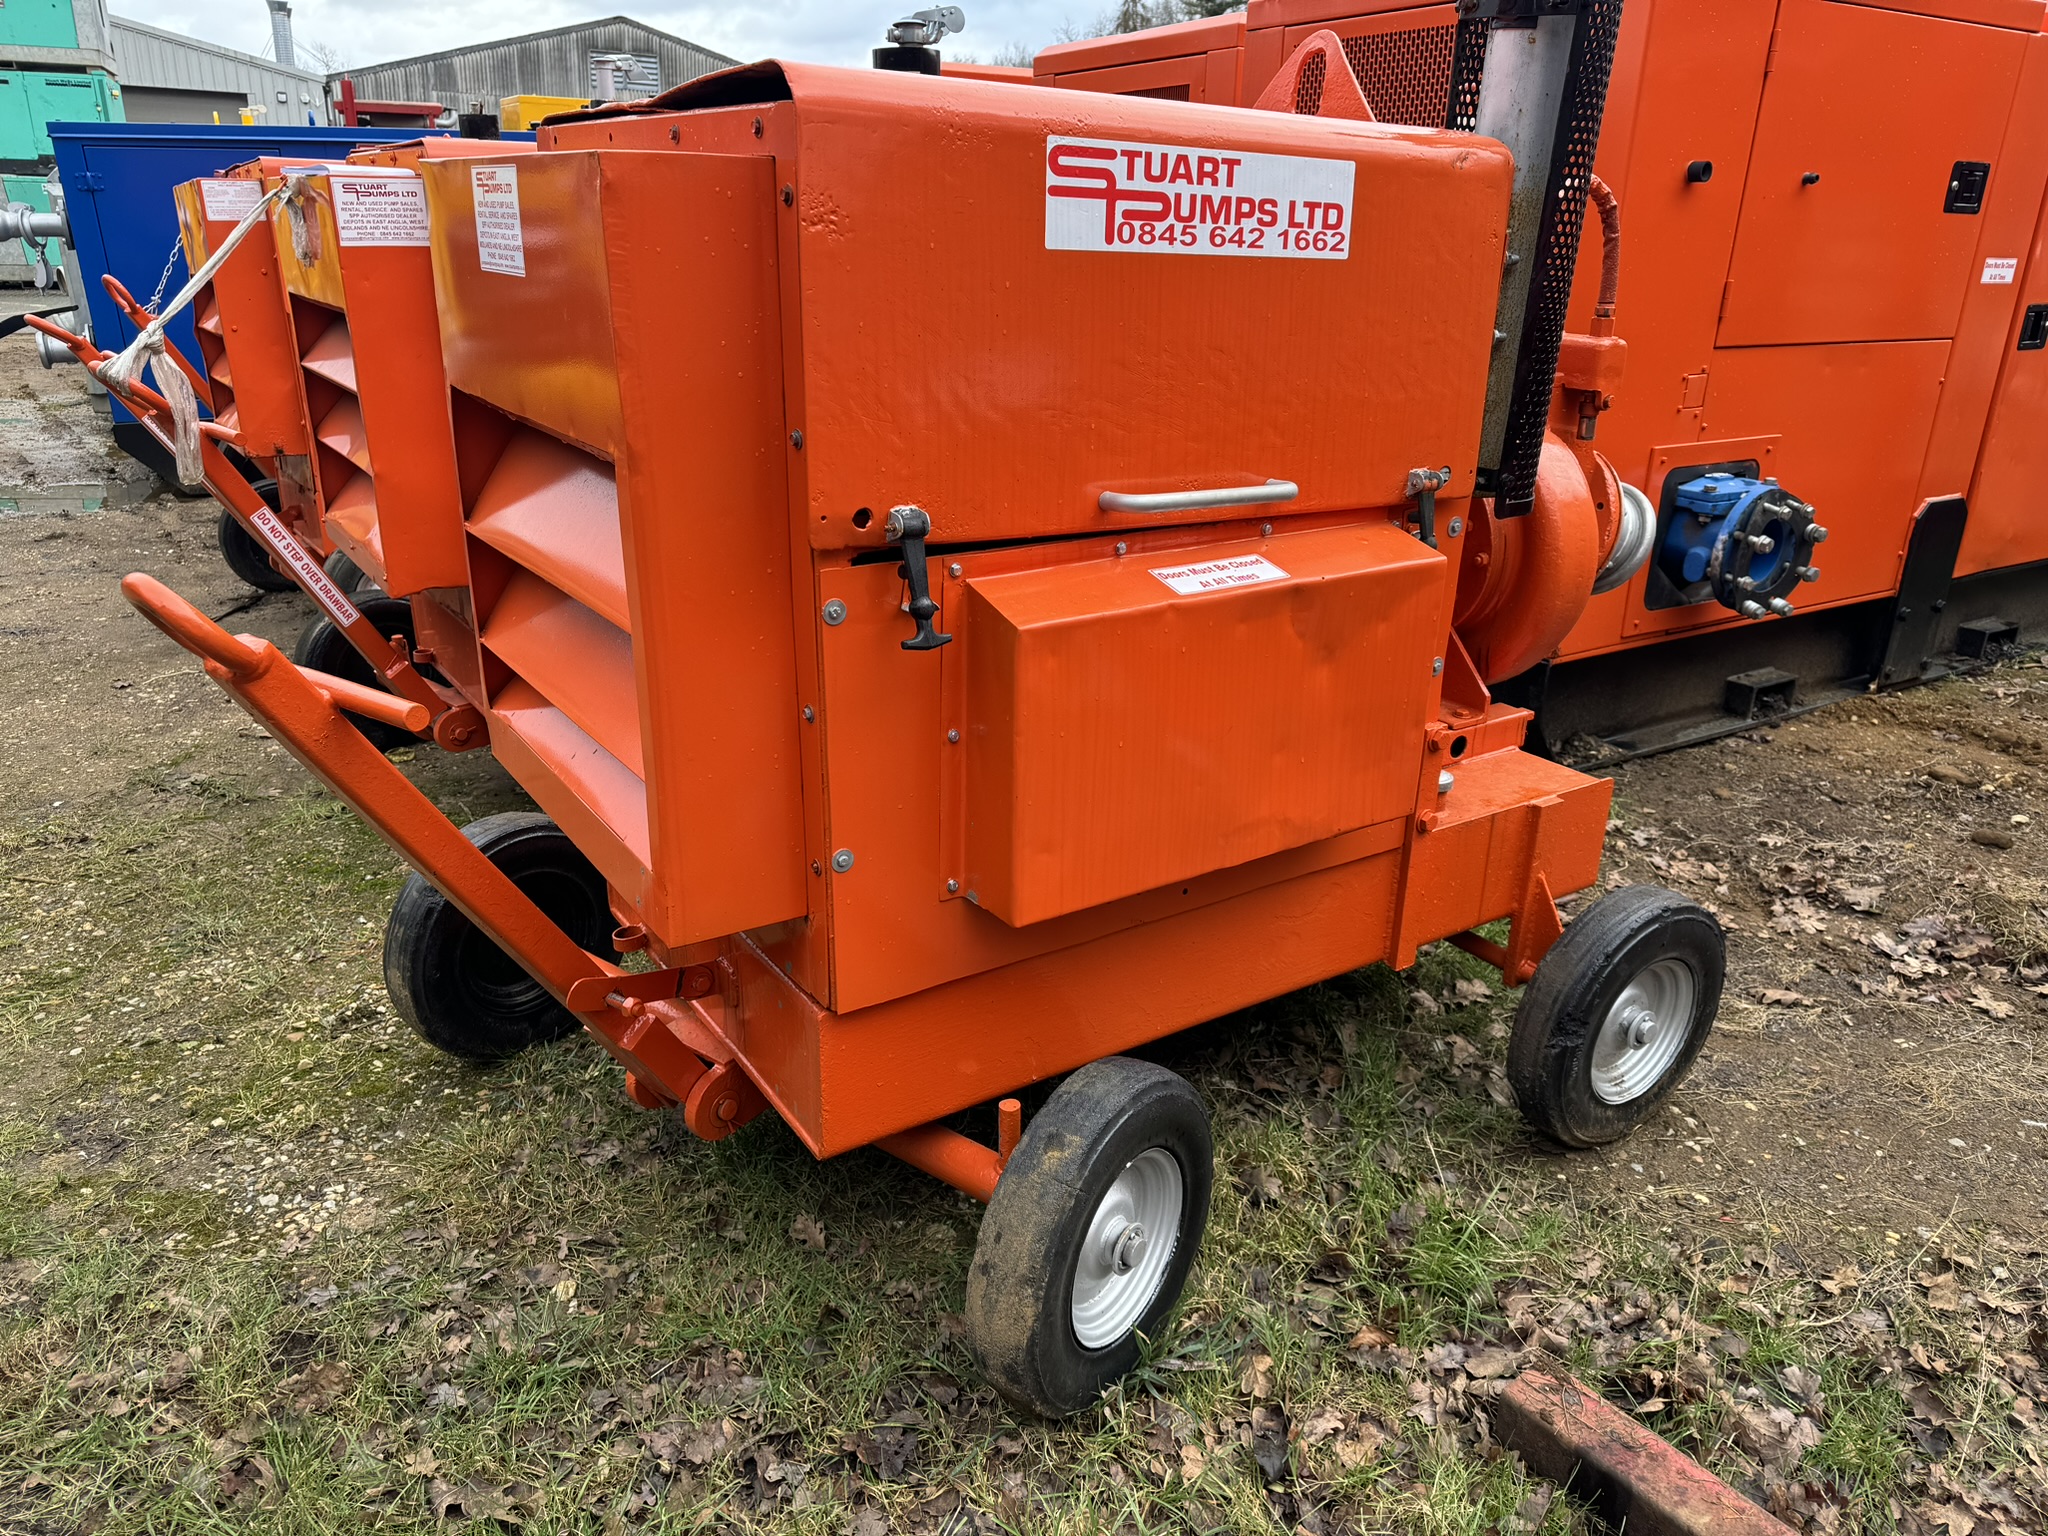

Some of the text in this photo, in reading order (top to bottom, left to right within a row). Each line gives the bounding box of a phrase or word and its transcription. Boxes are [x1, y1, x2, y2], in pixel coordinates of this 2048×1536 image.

[1048, 143, 1241, 188] STUART
[476, 171, 496, 182] STUART
[342, 183, 388, 191] STUART
[342, 191, 400, 201] PUMPS
[477, 183, 512, 200] PUMPS LTD
[1047, 184, 1345, 245] PUMPS LTD
[1117, 221, 1346, 252] 0845 642 1662
[257, 512, 353, 622] DO NOT STEP OVER DRAWBAR
[1158, 558, 1264, 580] Doors Must Be Closed
[1199, 572, 1260, 588] At All Times
